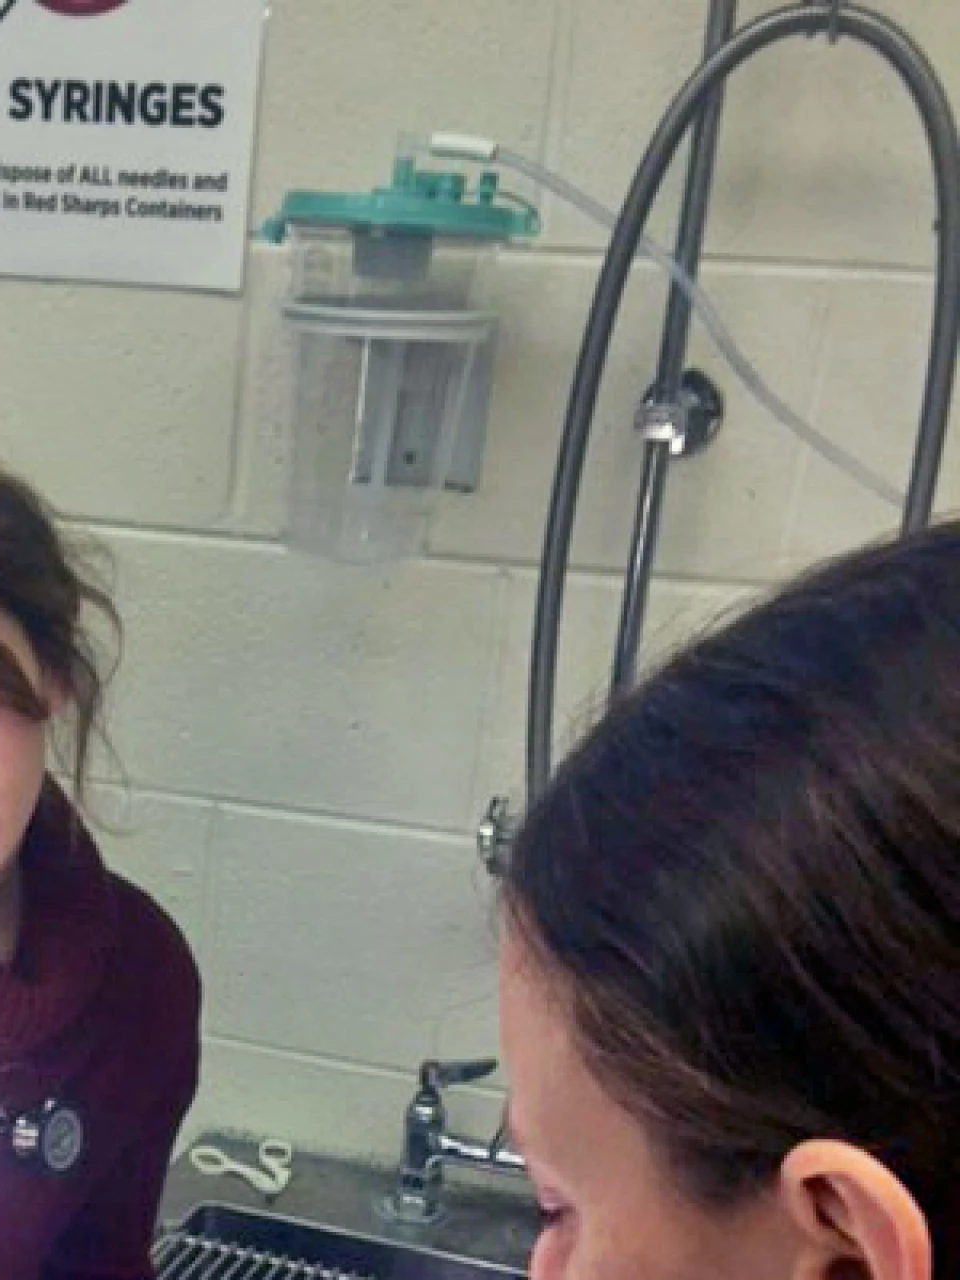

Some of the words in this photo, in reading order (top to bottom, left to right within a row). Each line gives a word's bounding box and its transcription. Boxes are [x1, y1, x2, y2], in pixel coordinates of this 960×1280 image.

[9, 78, 226, 128] SYRINGES
[57, 163, 77, 183] of
[80, 166, 112, 186] ALL
[118, 168, 189, 190] needles
[192, 171, 228, 192] and
[2, 189, 19, 209] in
[23, 191, 58, 212] Red
[62, 194, 120, 218] Sharps
[125, 197, 224, 222] Containers
